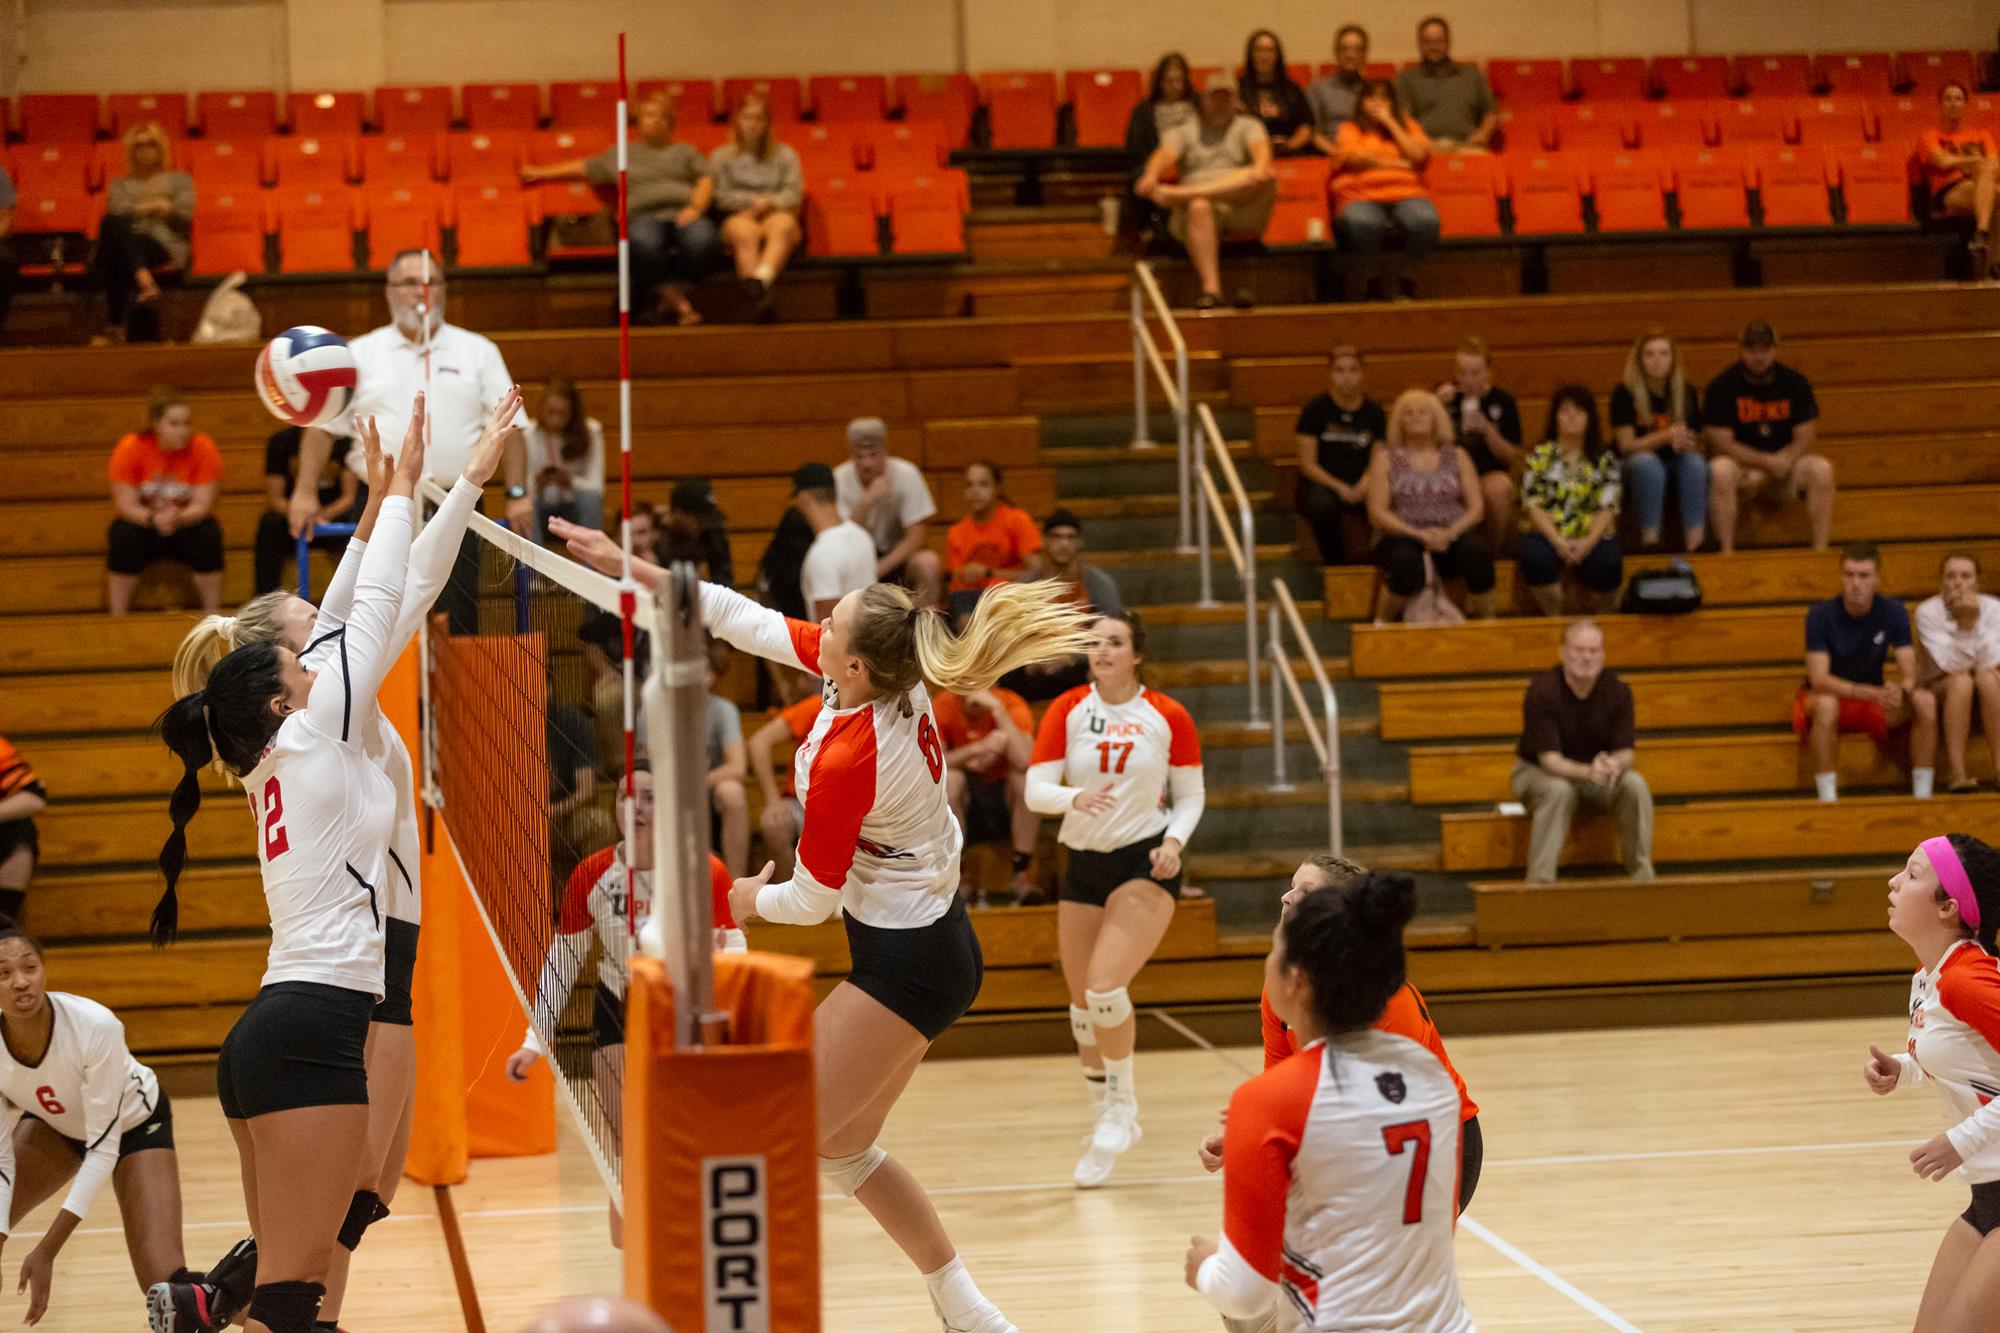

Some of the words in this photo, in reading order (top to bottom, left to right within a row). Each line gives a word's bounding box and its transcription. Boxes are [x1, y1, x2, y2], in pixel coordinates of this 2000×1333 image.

[1096, 741, 1134, 774] 17
[35, 1085, 66, 1115] 6
[1381, 1119, 1431, 1225] 7
[711, 1165, 759, 1329] PORT
